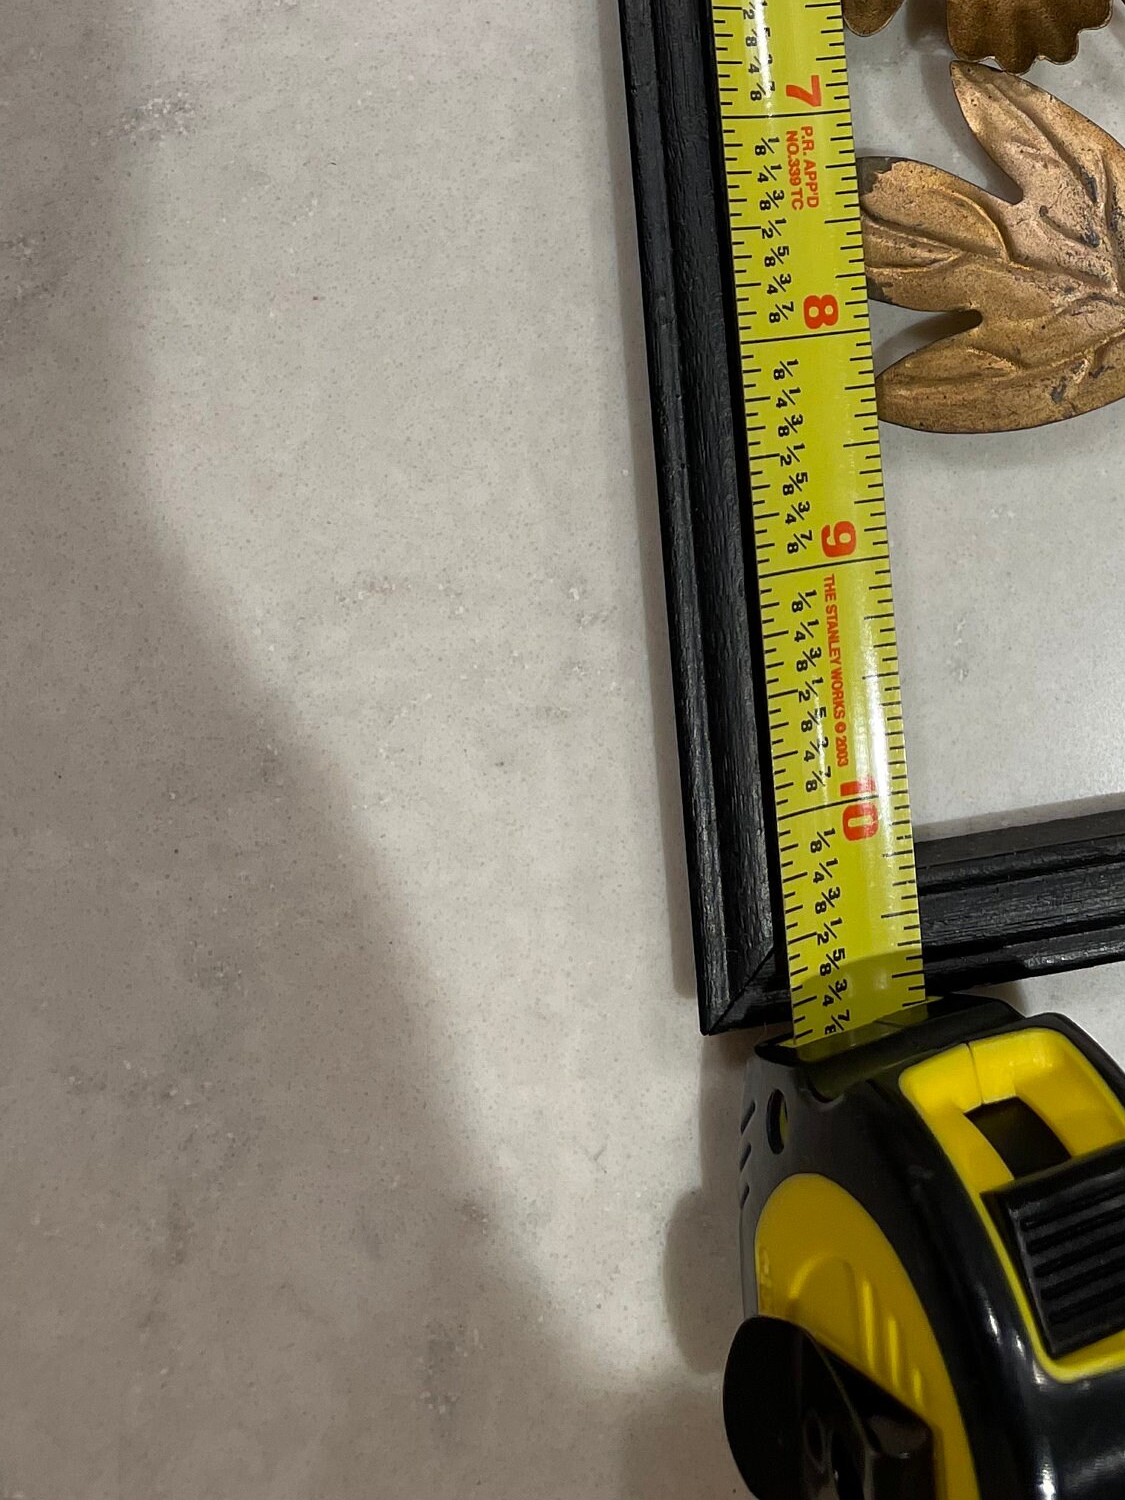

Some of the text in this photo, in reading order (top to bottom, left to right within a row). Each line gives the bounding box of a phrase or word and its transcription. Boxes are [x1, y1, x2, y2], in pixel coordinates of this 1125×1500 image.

[786, 75, 822, 107] 7
[754, 136, 779, 156] 1/8
[757, 164, 782, 183] 1/4
[759, 190, 785, 211] 3/8
[762, 218, 787, 239] 1/2
[764, 246, 790, 267] 5/8
[766, 273, 792, 294] 3/4
[769, 301, 794, 324] 7/8
[803, 294, 839, 329] 8
[773, 359, 799, 381] 1/8
[775, 387, 801, 409] 1/4
[778, 414, 803, 438] 3/8
[780, 442, 805, 467] 1/2
[782, 472, 808, 496] 5/8
[785, 500, 810, 525] 3/4
[787, 530, 812, 554] 7/8
[821, 521, 857, 558] 9
[791, 589, 818, 613] 1/8
[794, 619, 819, 643] 1/4
[825, 604, 840, 664] STANLEY
[796, 647, 822, 672] 3/8
[798, 677, 824, 703] 1/2
[831, 664, 846, 720] WORKS
[840, 774, 879, 842] 10
[810, 828, 836, 853] 1/8
[813, 858, 838, 884] 1/4
[815, 887, 841, 914] 3/8
[817, 918, 843, 946] 1/2
[820, 948, 846, 976] 5/8
[822, 979, 848, 1007] 3/4
